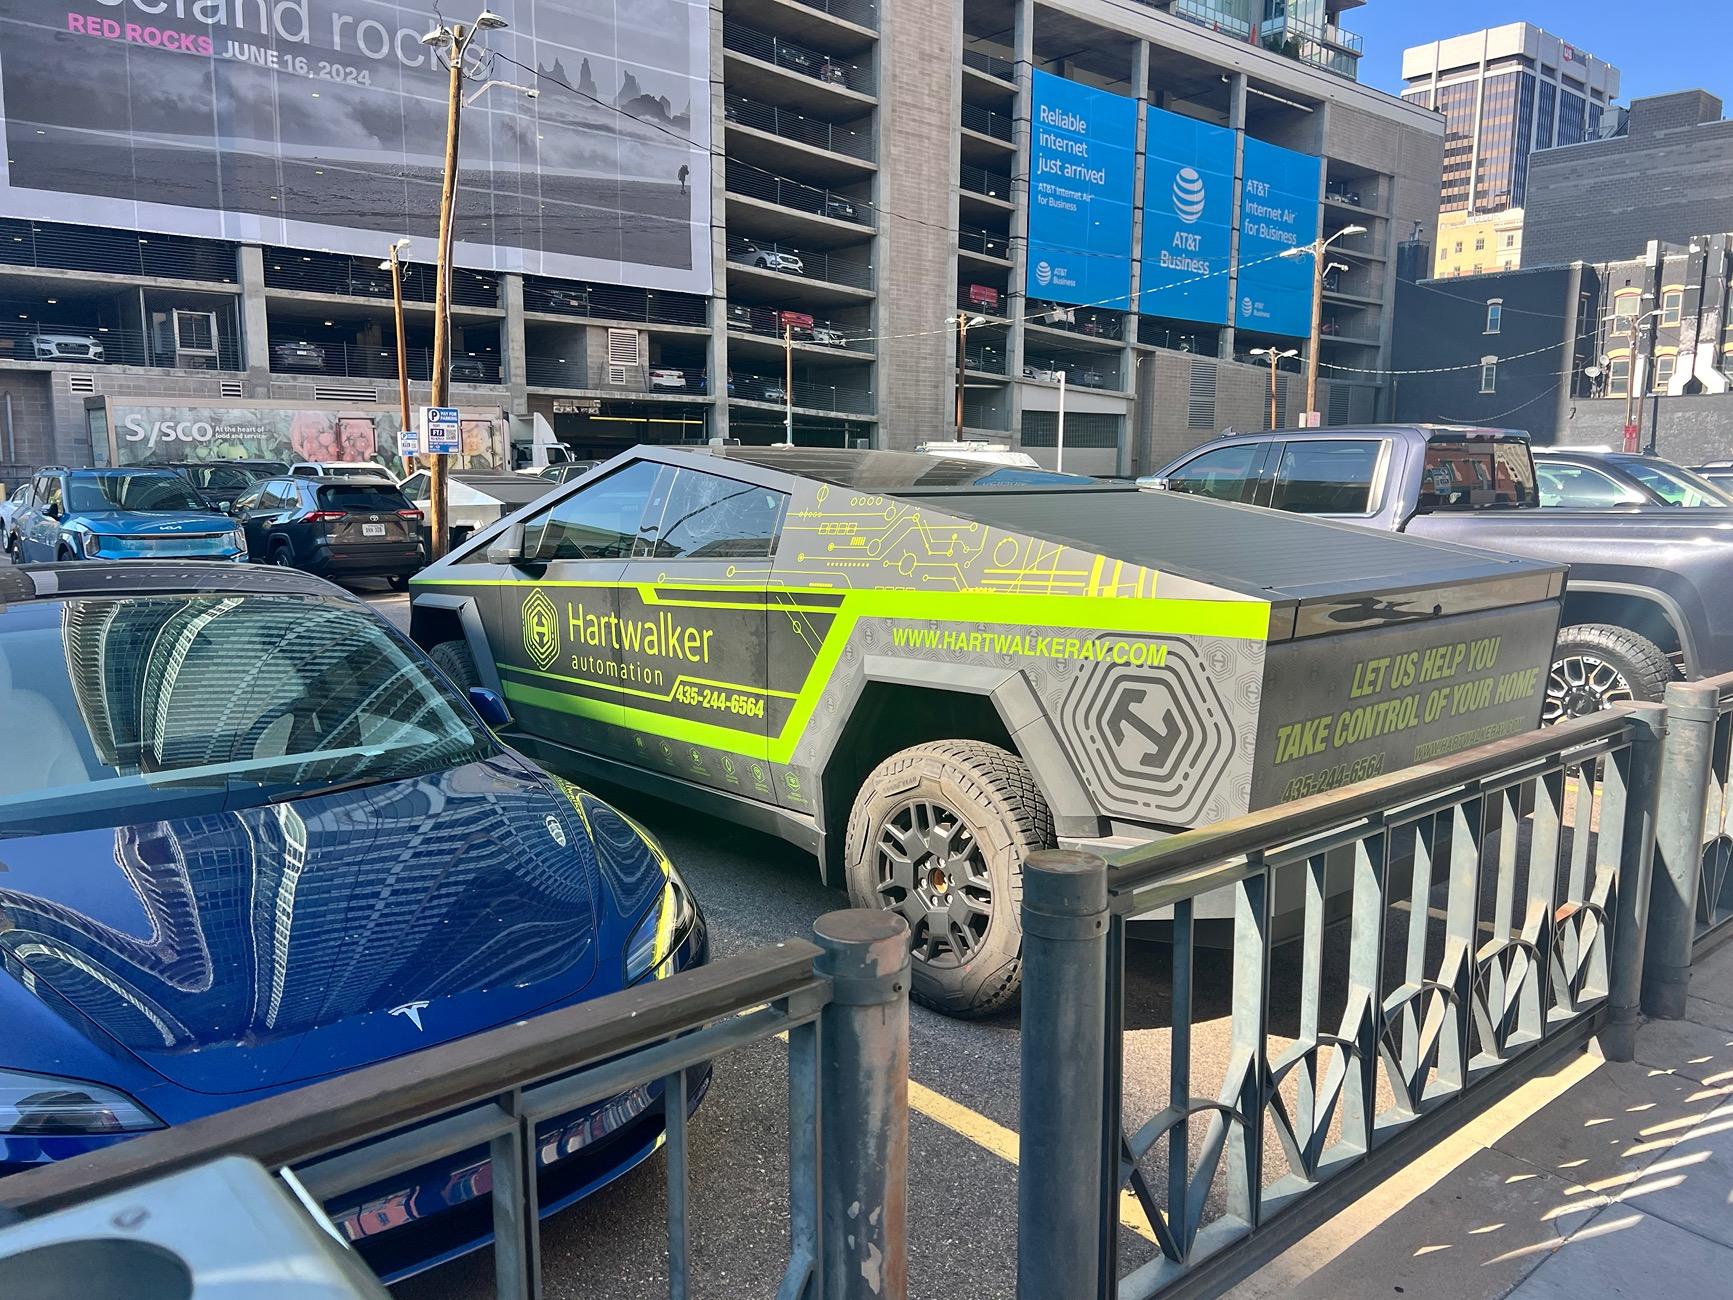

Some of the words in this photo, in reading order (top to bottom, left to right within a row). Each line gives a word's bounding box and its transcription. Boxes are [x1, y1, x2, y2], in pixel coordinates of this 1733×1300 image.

[95, 0, 310, 44] and
[67, 12, 121, 39] RED
[125, 23, 213, 56] ROCKS
[222, 40, 279, 68] JUNE
[284, 54, 314, 79] 16,
[319, 61, 372, 87] 2024
[1040, 105, 1087, 134] Reliable
[1039, 129, 1088, 158] internet
[1037, 153, 1061, 175] just
[1064, 163, 1105, 185] arrived
[1038, 183, 1055, 194] AT&T
[1056, 187, 1081, 200] Internet
[1038, 194, 1048, 205] for
[1048, 197, 1077, 211] Business
[1246, 179, 1270, 198] AT&T
[1245, 199, 1282, 222] Internet
[1173, 231, 1202, 251] AT&T
[1244, 219, 1258, 234] for
[1260, 225, 1297, 245] Business
[1053, 268, 1067, 277] AT&T
[1160, 250, 1210, 274] Business
[1053, 277, 1076, 287] Business
[567, 601, 714, 664] Hartwalker
[892, 628, 1168, 668] WWW.HARTWALKERAV.COM
[571, 654, 664, 686] automation
[1350, 663, 1390, 699] LET
[1390, 651, 1419, 690] US
[1419, 643, 1466, 684] HELP
[1467, 636, 1502, 672] YOU
[676, 684, 765, 719] 435-244-6564
[1274, 716, 1332, 765] TAKE
[1333, 698, 1420, 750] CONTROL
[1423, 689, 1451, 725] OF
[1448, 679, 1494, 717] YOUR
[1493, 667, 1540, 705] HOME
[1280, 752, 1386, 803] 435-244-6564
